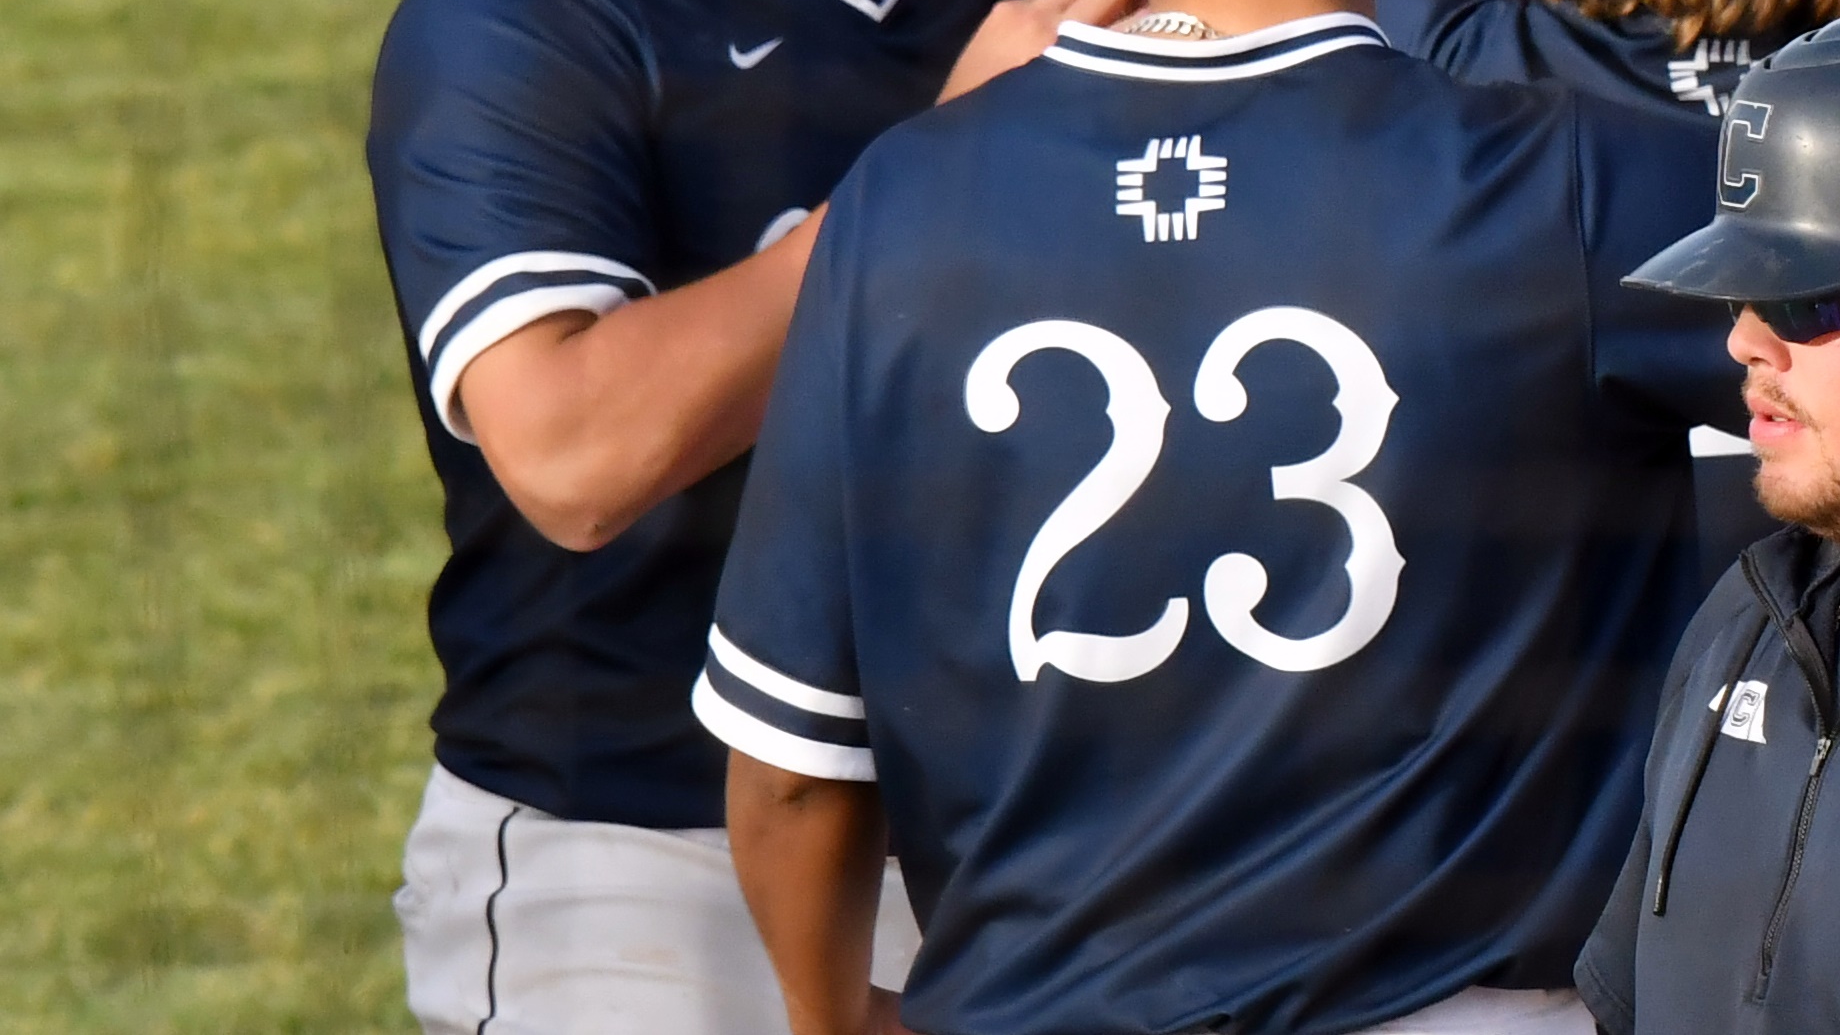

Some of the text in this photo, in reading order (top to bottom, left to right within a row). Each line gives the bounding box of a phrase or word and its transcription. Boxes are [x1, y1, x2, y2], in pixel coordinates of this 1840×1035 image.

[1718, 99, 1772, 209] C
[964, 305, 1406, 682] 23
[1730, 688, 1761, 728] C
